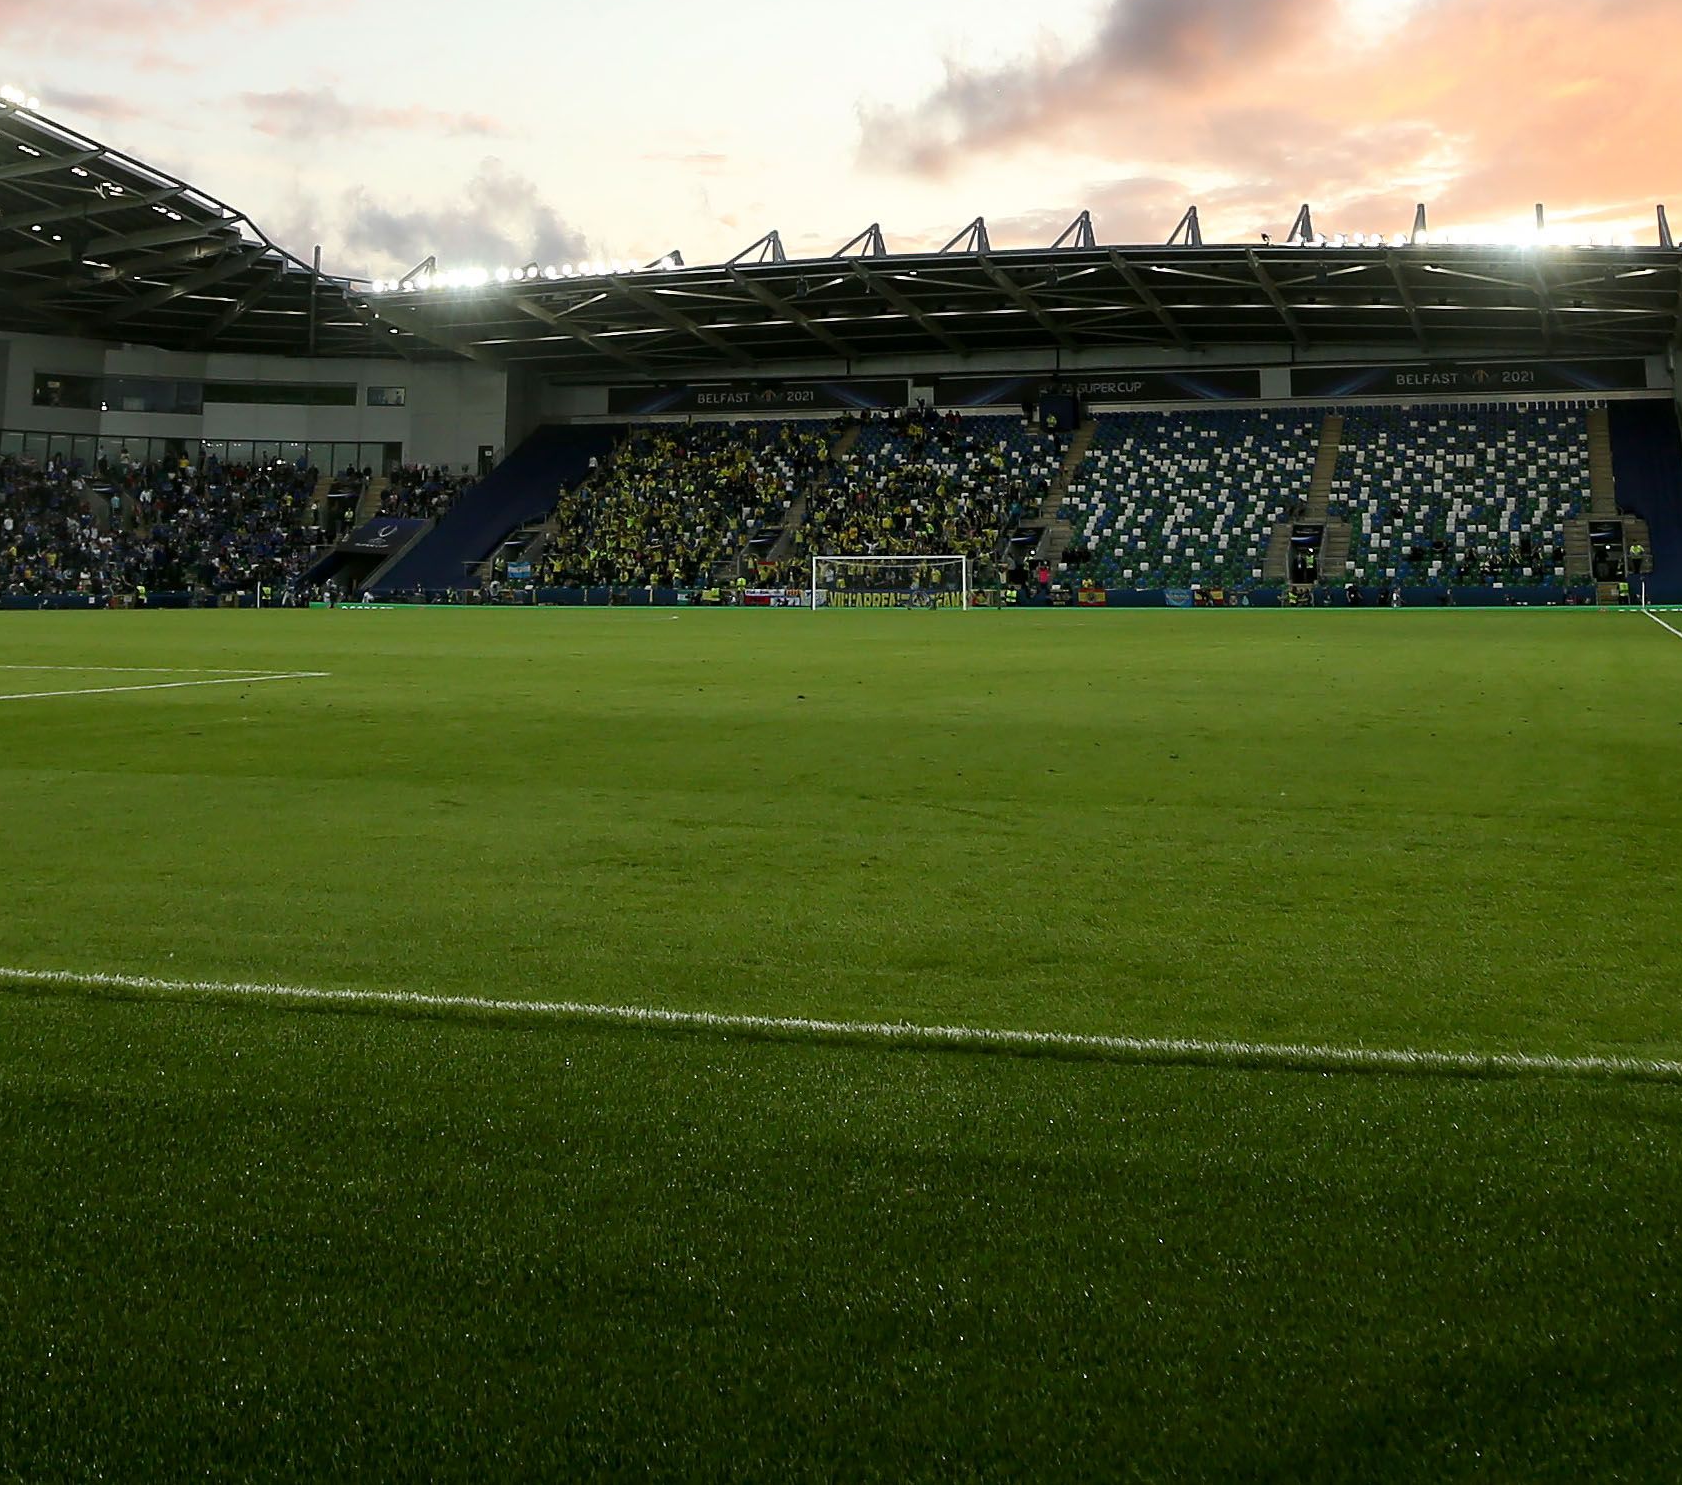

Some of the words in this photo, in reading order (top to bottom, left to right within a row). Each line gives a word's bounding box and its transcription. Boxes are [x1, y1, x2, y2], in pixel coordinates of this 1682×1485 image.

[1396, 373, 1459, 385] BELFAST
[1501, 370, 1534, 383] 2021
[1077, 383, 1116, 394] SUPER
[1117, 381, 1143, 393] CUP
[697, 393, 750, 404] BELFAST
[786, 391, 814, 402] 2021
